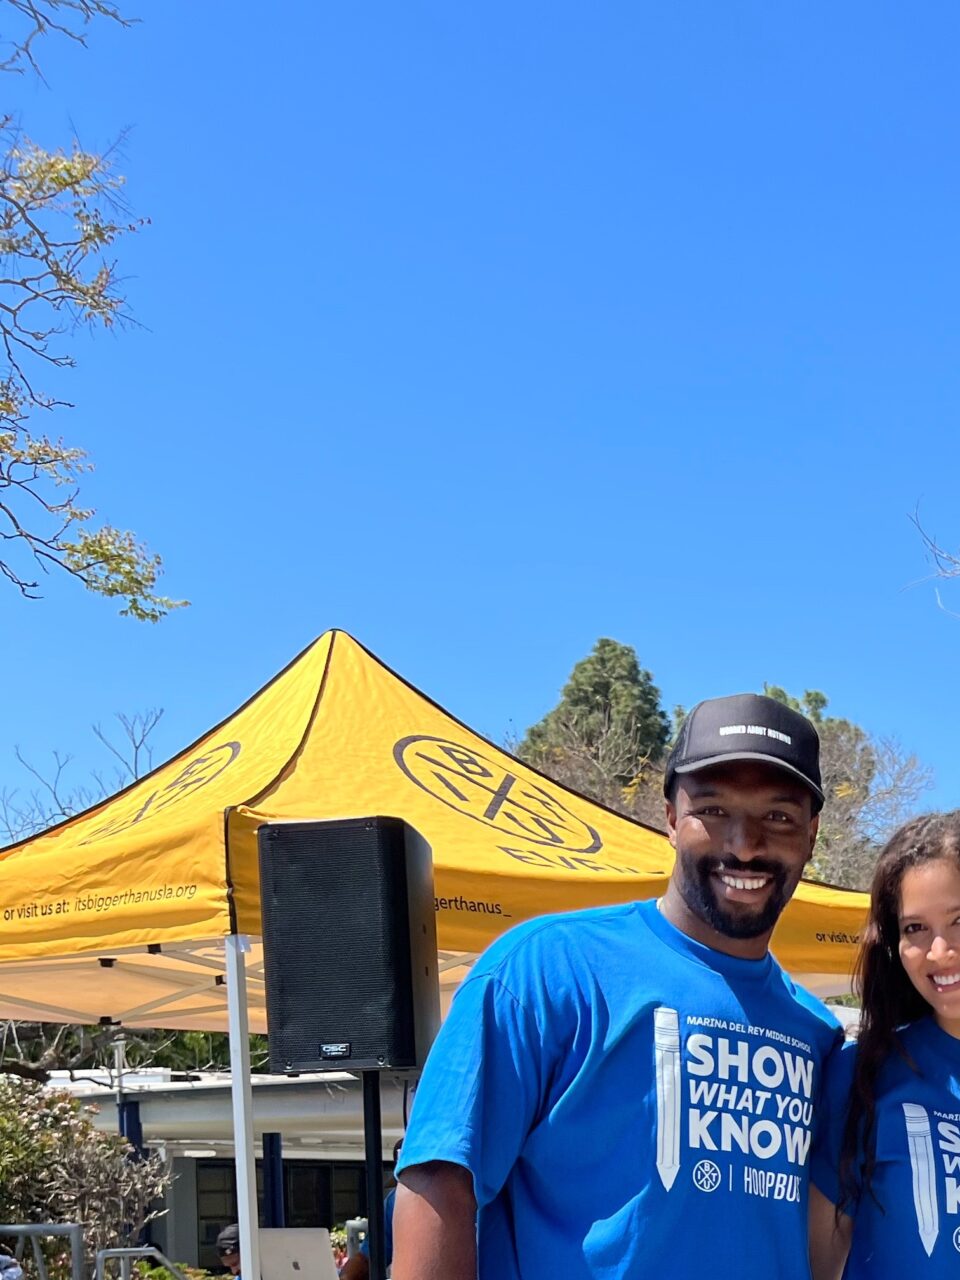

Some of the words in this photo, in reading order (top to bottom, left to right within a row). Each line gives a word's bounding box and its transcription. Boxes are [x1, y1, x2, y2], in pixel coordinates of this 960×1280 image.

[4, 909, 15, 921] or
[17, 903, 38, 919] visit
[41, 904, 53, 916] us
[55, 901, 70, 915] at:
[74, 884, 197, 912] itsbiggerthanusla.org
[828, 931, 849, 944] visit
[687, 1015, 728, 1029] MARINA
[729, 1022, 746, 1033] DEL
[747, 1023, 765, 1036] REY
[765, 1029, 791, 1045] MIDDLE
[686, 1033, 814, 1098] SHOW
[689, 1079, 771, 1115] WHAT
[775, 1093, 813, 1126] YOU
[688, 1108, 811, 1166] KNOW
